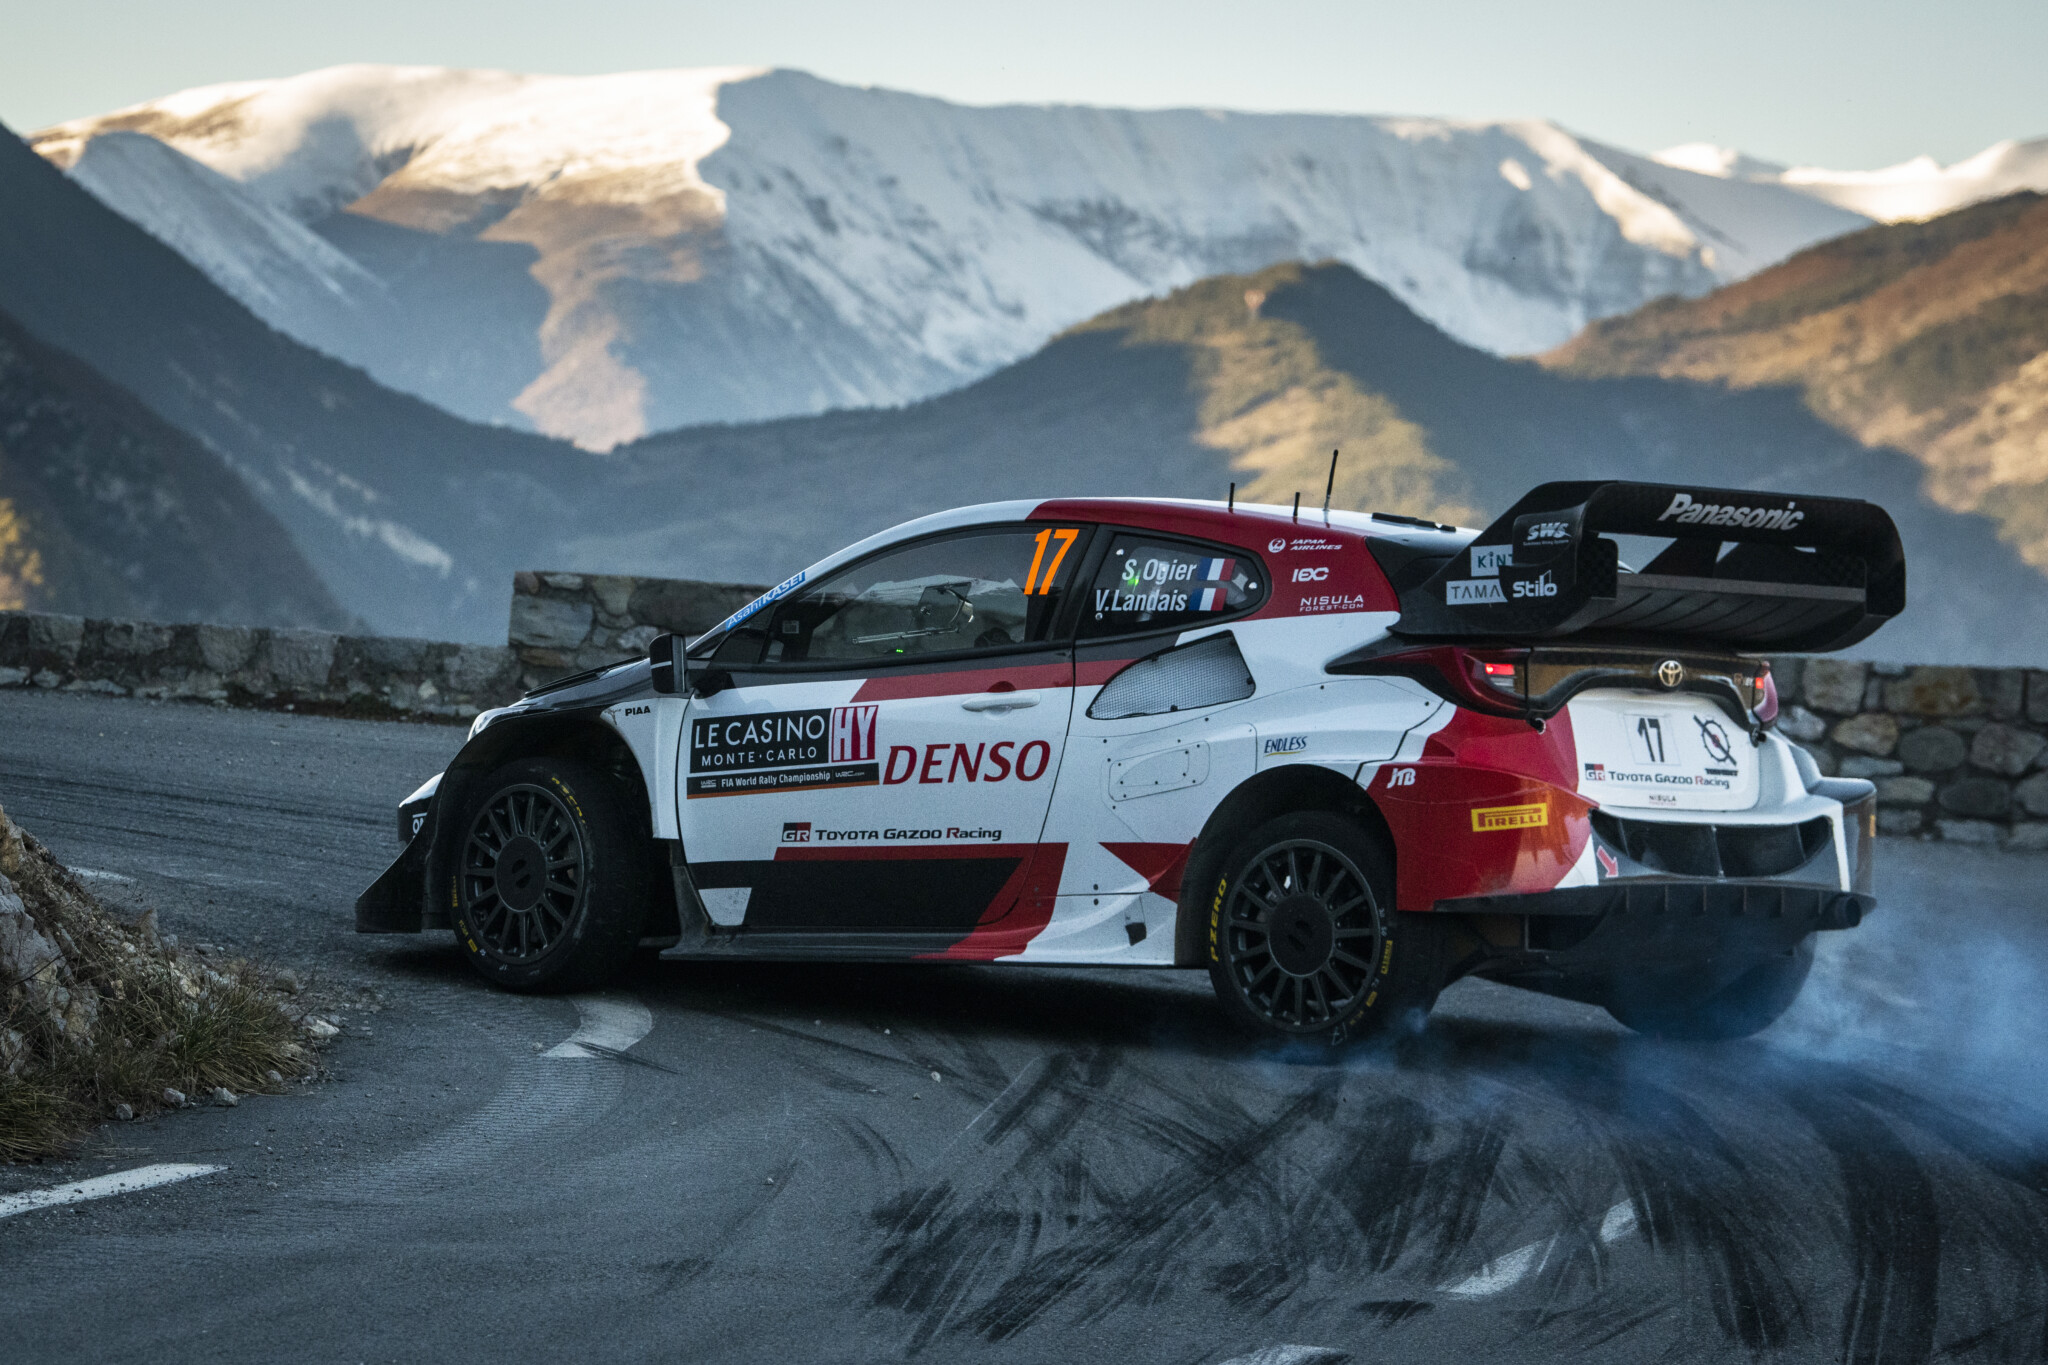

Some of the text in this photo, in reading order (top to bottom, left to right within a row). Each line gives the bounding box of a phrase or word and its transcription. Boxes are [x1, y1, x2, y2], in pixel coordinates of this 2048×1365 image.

[1657, 493, 1804, 530] Panasonic
[1527, 522, 1571, 540] SWS
[1023, 528, 1080, 595] 17
[1512, 569, 1557, 598] Stilo
[1300, 594, 1364, 606] NISULA
[625, 705, 651, 716] PIAA
[694, 715, 826, 749] LE CASINO
[832, 706, 878, 762] HY
[1637, 717, 1665, 762] 17
[1264, 736, 1308, 753] ENDLESS
[883, 740, 1051, 785] DENSO
[721, 778, 734, 788] FIA
[735, 776, 757, 786] World
[759, 774, 777, 785] Rally
[779, 771, 831, 784] Championship
[1387, 767, 1416, 789] JTB
[1586, 769, 1730, 789] GR TOYOTA GAZOO Racing
[1477, 807, 1543, 829] PIRELLI
[783, 827, 1002, 842] GR TOYOTA GAZOO Racing
